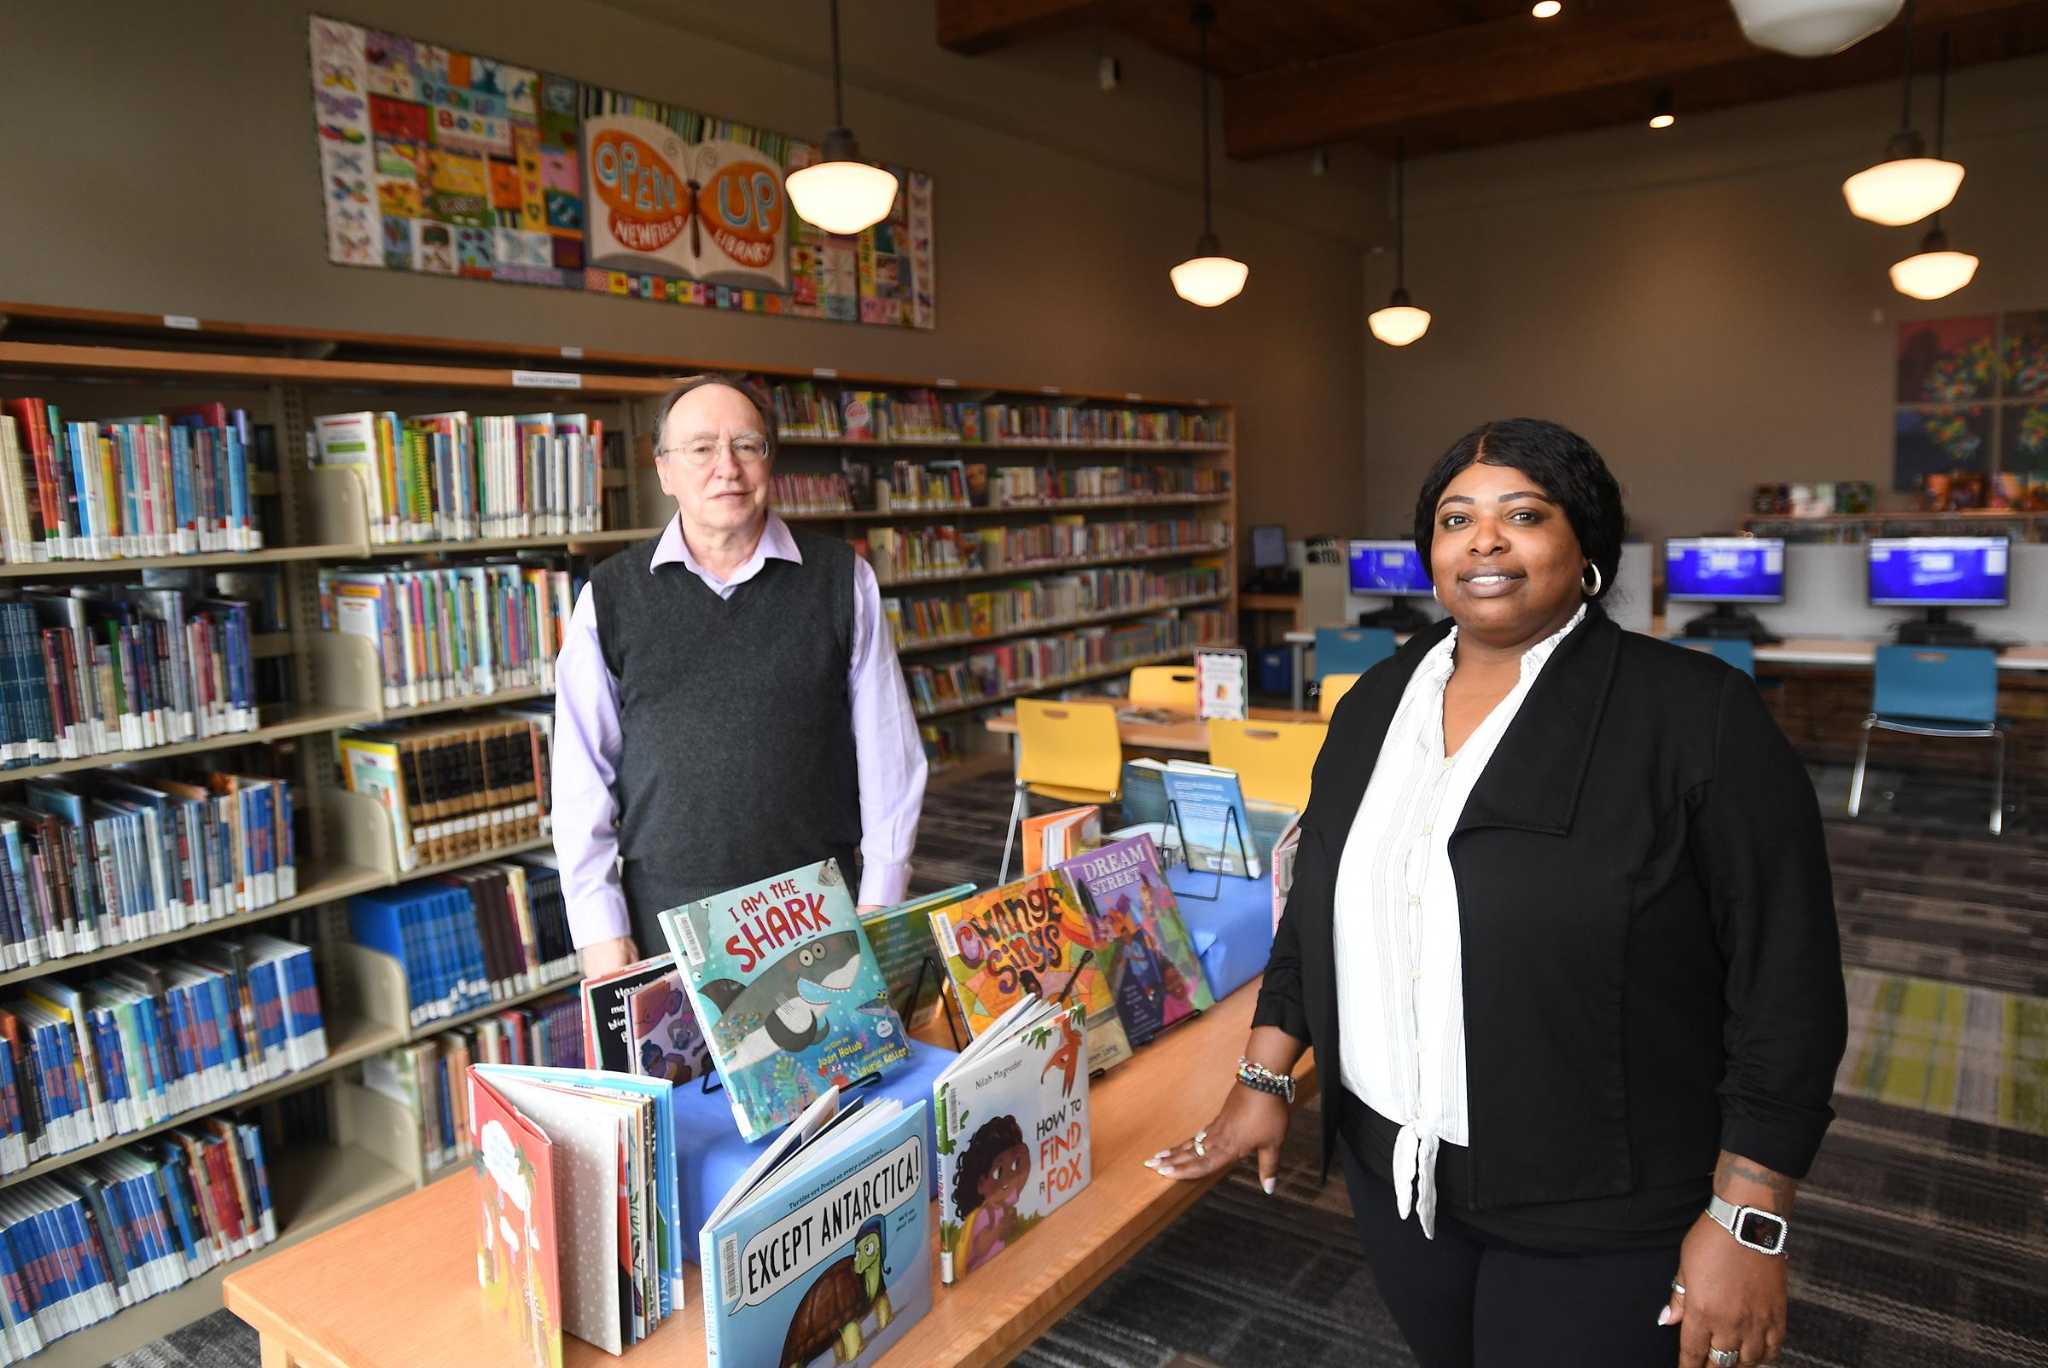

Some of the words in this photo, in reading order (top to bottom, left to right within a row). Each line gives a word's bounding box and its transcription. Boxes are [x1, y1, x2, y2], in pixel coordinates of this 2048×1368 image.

[595, 142, 676, 210] OPEN
[719, 171, 776, 234] UP
[714, 228, 773, 263] LIBRARY
[1083, 843, 1147, 882] DREAM
[1089, 866, 1142, 897] STREET
[728, 907, 741, 923] I
[740, 891, 769, 917] AM
[769, 878, 800, 899] THE
[725, 893, 832, 973] SHARK
[1036, 1104, 1066, 1141] HOW
[1070, 1099, 1082, 1117] TO
[1047, 1152, 1082, 1204] FOX
[747, 1215, 814, 1295] EXCEPT
[821, 1145, 920, 1247] ANTARCTICA!
